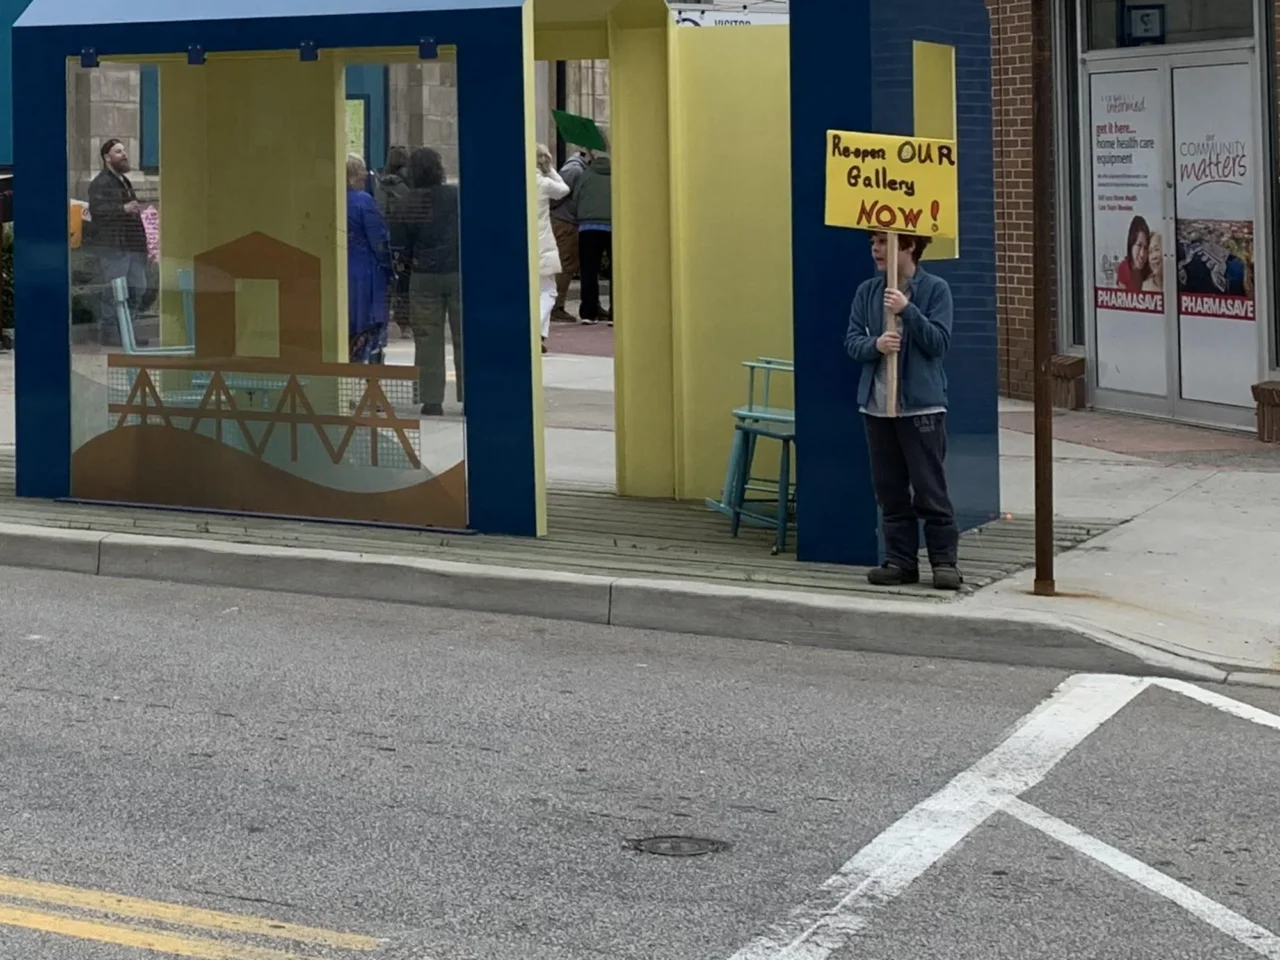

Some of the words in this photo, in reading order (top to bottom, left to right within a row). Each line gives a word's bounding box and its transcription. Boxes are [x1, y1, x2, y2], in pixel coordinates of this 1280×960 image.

[1096, 124, 1107, 137] get
[1096, 138, 1115, 149] home
[1116, 136, 1138, 149] health
[1139, 139, 1155, 149] care
[1180, 141, 1246, 157] COMMUNITY
[897, 141, 955, 166] OUR
[1096, 152, 1133, 167] equipment
[1180, 152, 1247, 182] matters
[847, 165, 915, 197] Gallery
[1098, 291, 1162, 310] PHARMASAVE
[1181, 295, 1253, 317] PHARMASAVE
